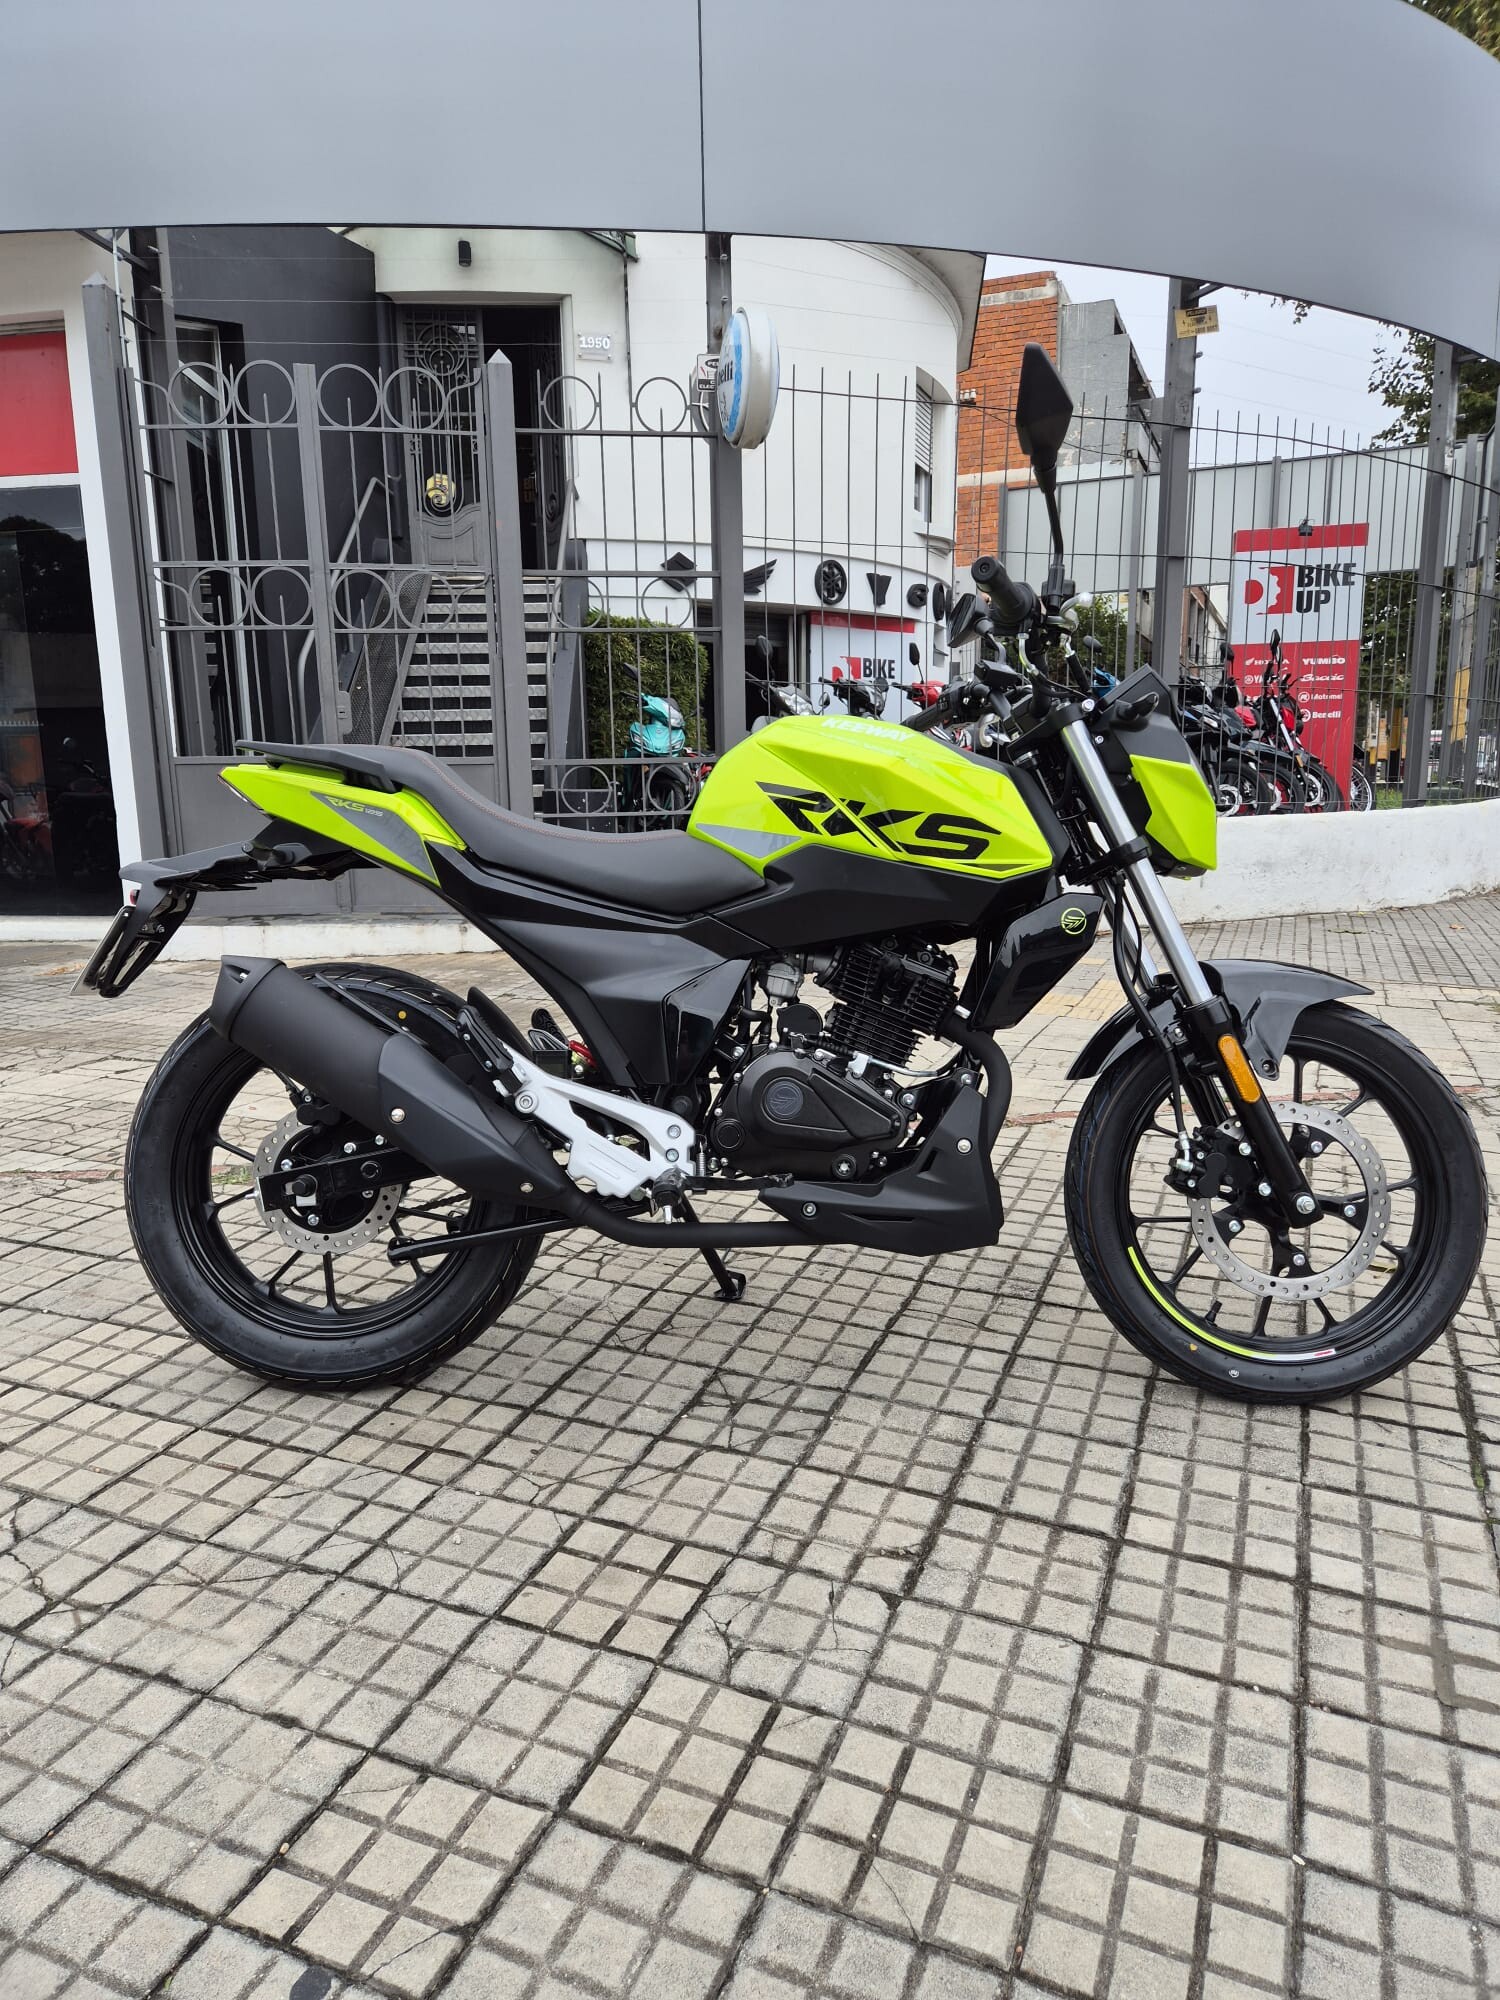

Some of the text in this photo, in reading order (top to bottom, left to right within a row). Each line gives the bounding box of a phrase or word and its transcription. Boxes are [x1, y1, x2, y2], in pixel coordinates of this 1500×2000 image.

[579, 336, 610, 349] 1950
[1297, 563, 1356, 588] BIKE
[1296, 590, 1331, 613] UP
[862, 658, 895, 679] BIKE
[821, 717, 918, 742] KEEWAY
[324, 795, 365, 812] RKS
[755, 781, 1002, 860] RKS
